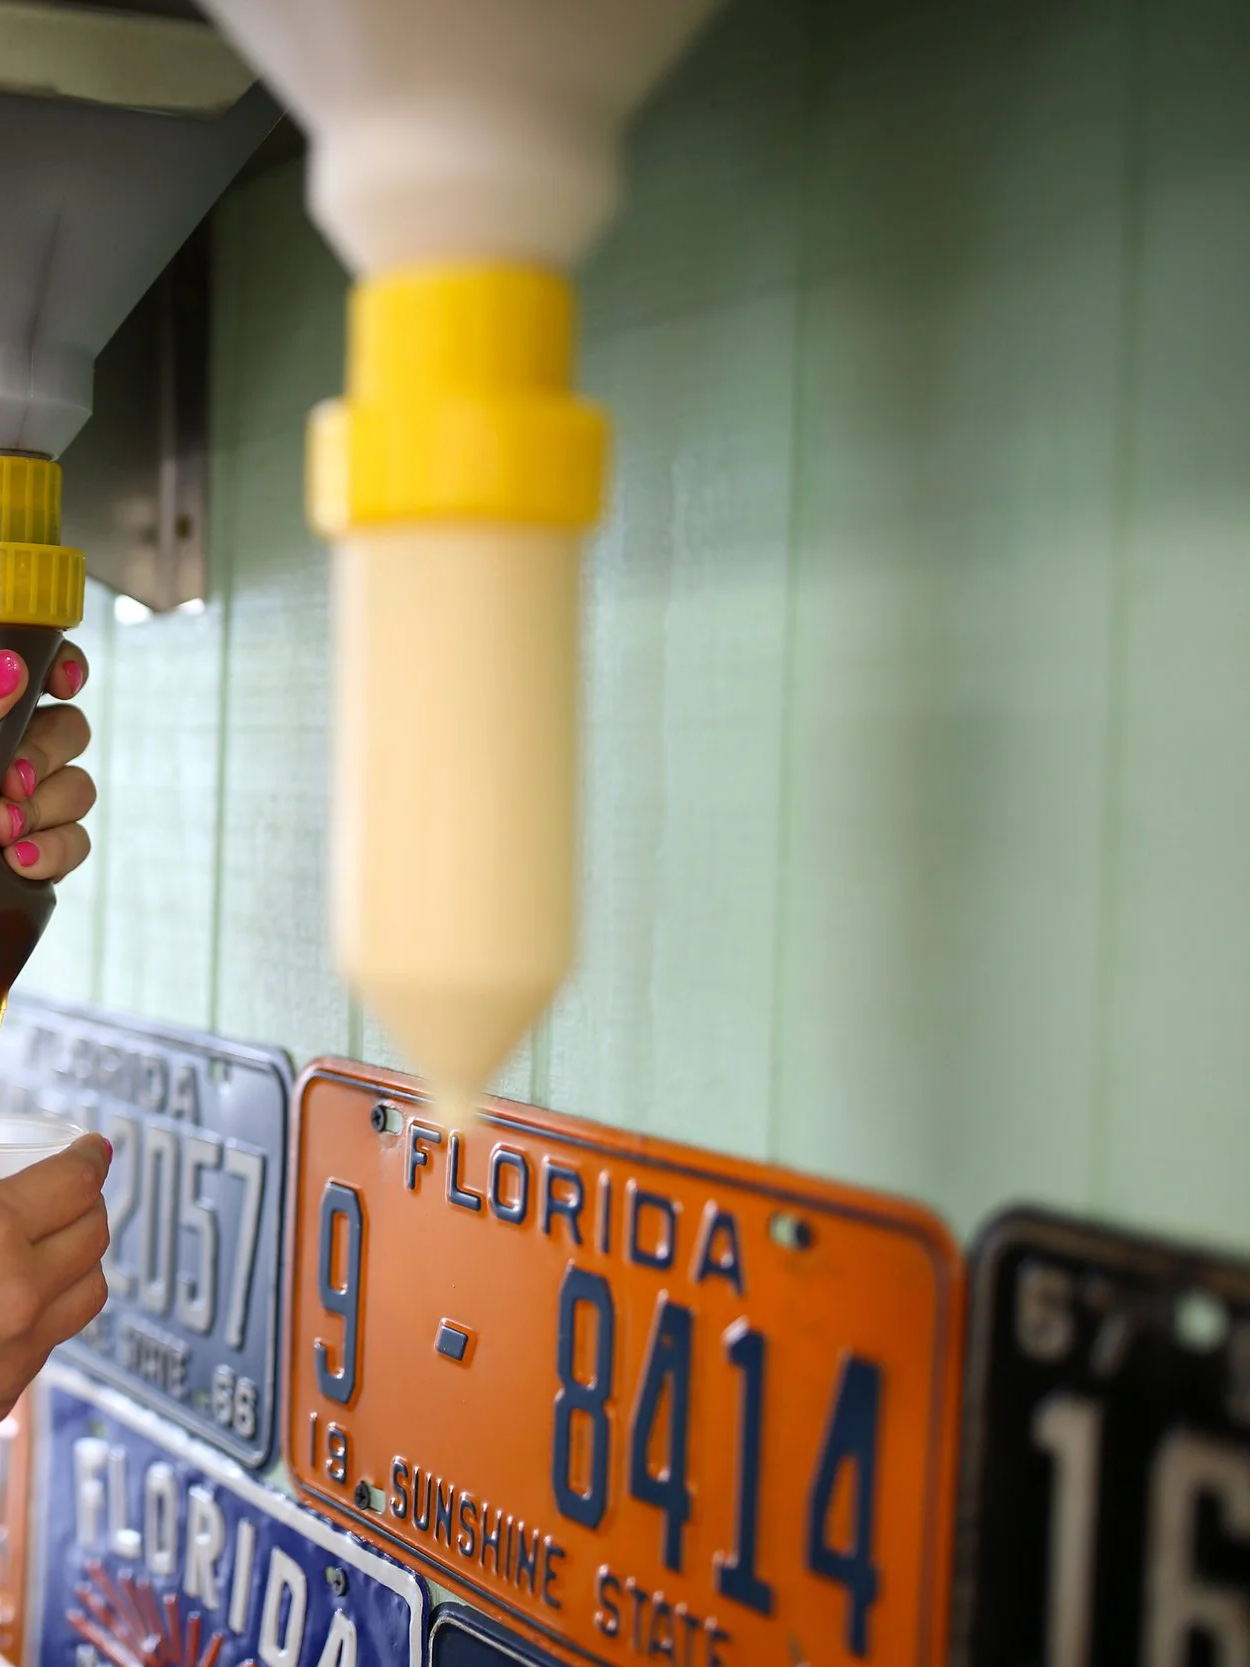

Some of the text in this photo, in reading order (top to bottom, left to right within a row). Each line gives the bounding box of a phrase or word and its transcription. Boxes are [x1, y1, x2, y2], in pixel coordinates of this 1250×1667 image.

[404, 1117, 746, 1297] FLORIDA
[310, 1412, 732, 1667] 19 SUNSHINE STATE
[313, 1178, 362, 1405] 9
[552, 1260, 884, 1660] 8414
